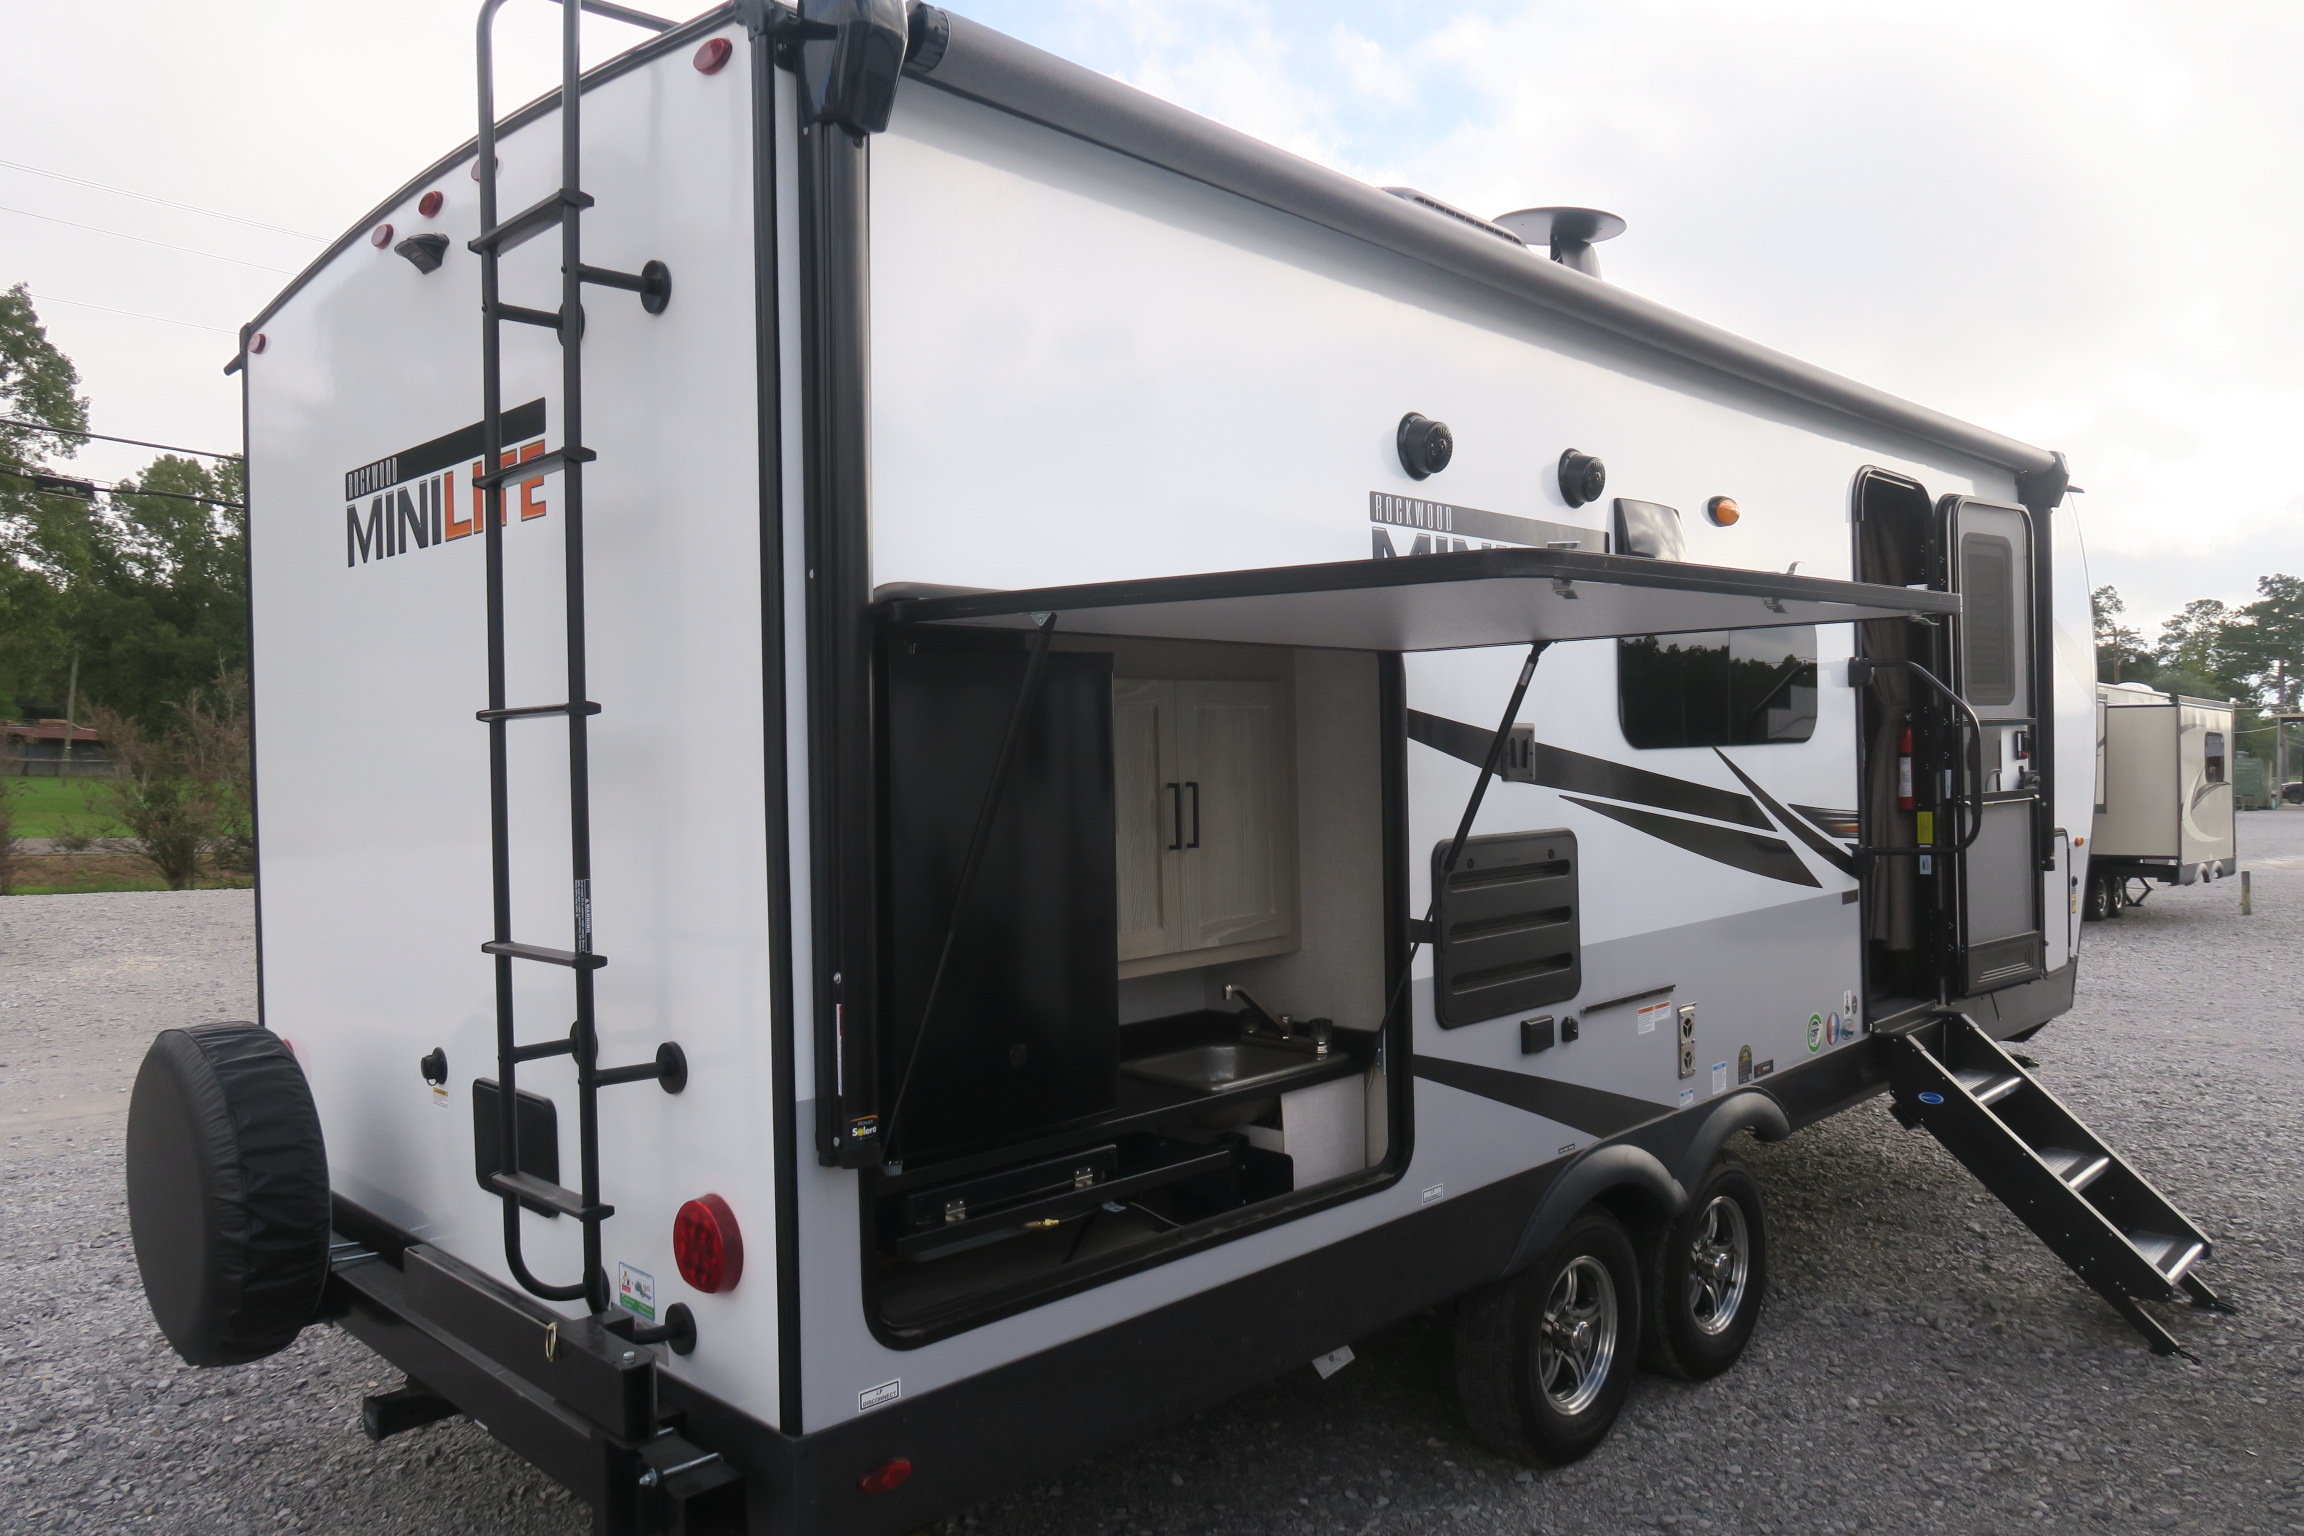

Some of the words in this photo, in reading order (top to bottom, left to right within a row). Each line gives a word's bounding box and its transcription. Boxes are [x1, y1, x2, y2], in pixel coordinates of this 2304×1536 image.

[348, 457, 398, 499] ROCKWOOD
[1375, 494, 1453, 531] ROCKWOOD
[852, 1126, 877, 1137] Solero
[863, 1391, 896, 1407] DISCONNECT
